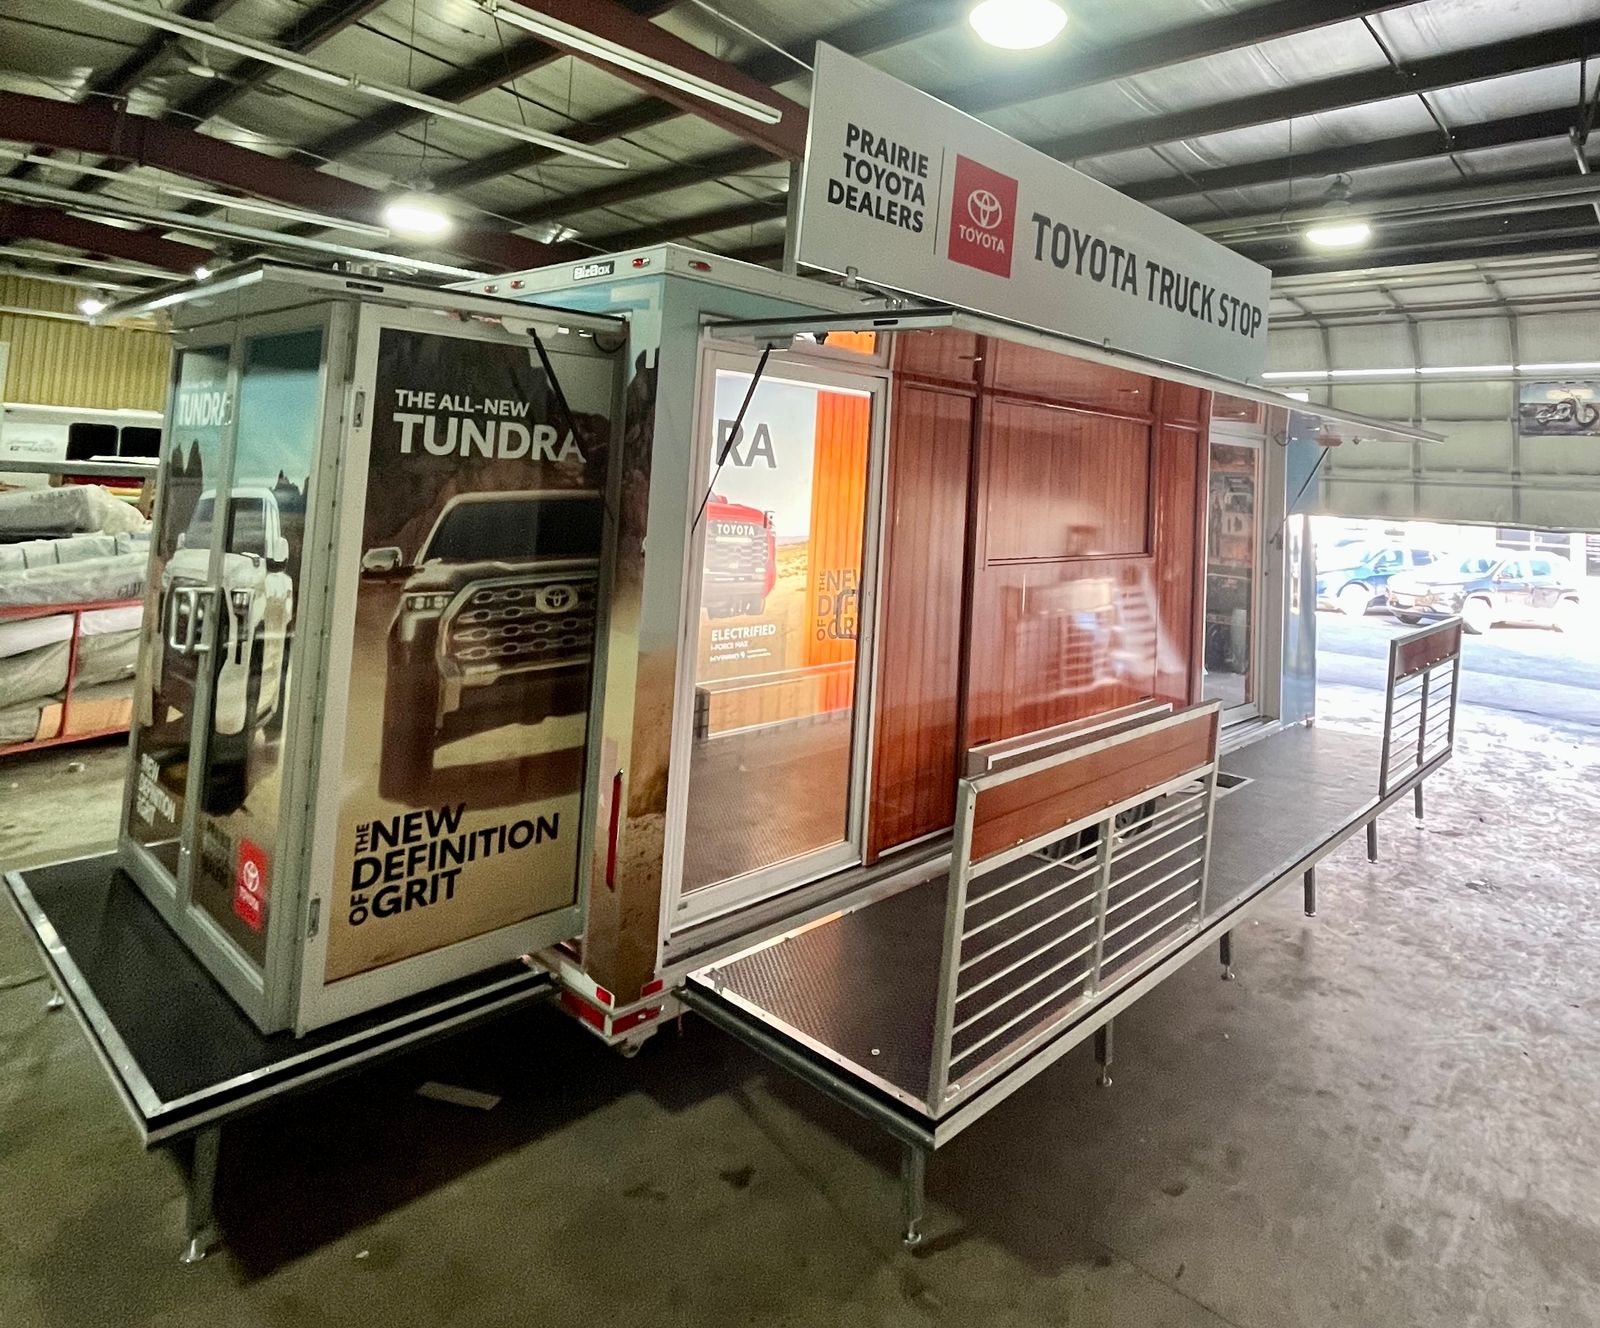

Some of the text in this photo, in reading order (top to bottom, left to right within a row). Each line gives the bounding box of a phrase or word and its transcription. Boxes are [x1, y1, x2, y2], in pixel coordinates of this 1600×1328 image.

[845, 122, 929, 179] PRAIRIE
[842, 151, 926, 207] TOYOTA
[827, 178, 924, 233] DEALERS
[958, 224, 1006, 254] TOYOTA
[574, 264, 610, 280] BizBox
[1031, 211, 1263, 339] TOYOTA TRUCK STOP
[395, 389, 531, 418] THE ALL-NEW
[392, 412, 587, 464] TUNDRA
[717, 523, 755, 536] TOYOTA
[818, 570, 826, 592] THE
[711, 623, 777, 642] ELECTRIFIED
[354, 822, 370, 856] THE
[370, 802, 467, 851] NEW
[351, 812, 560, 892] DEFINITION
[348, 893, 369, 926] OF
[371, 867, 462, 918] GRIT
